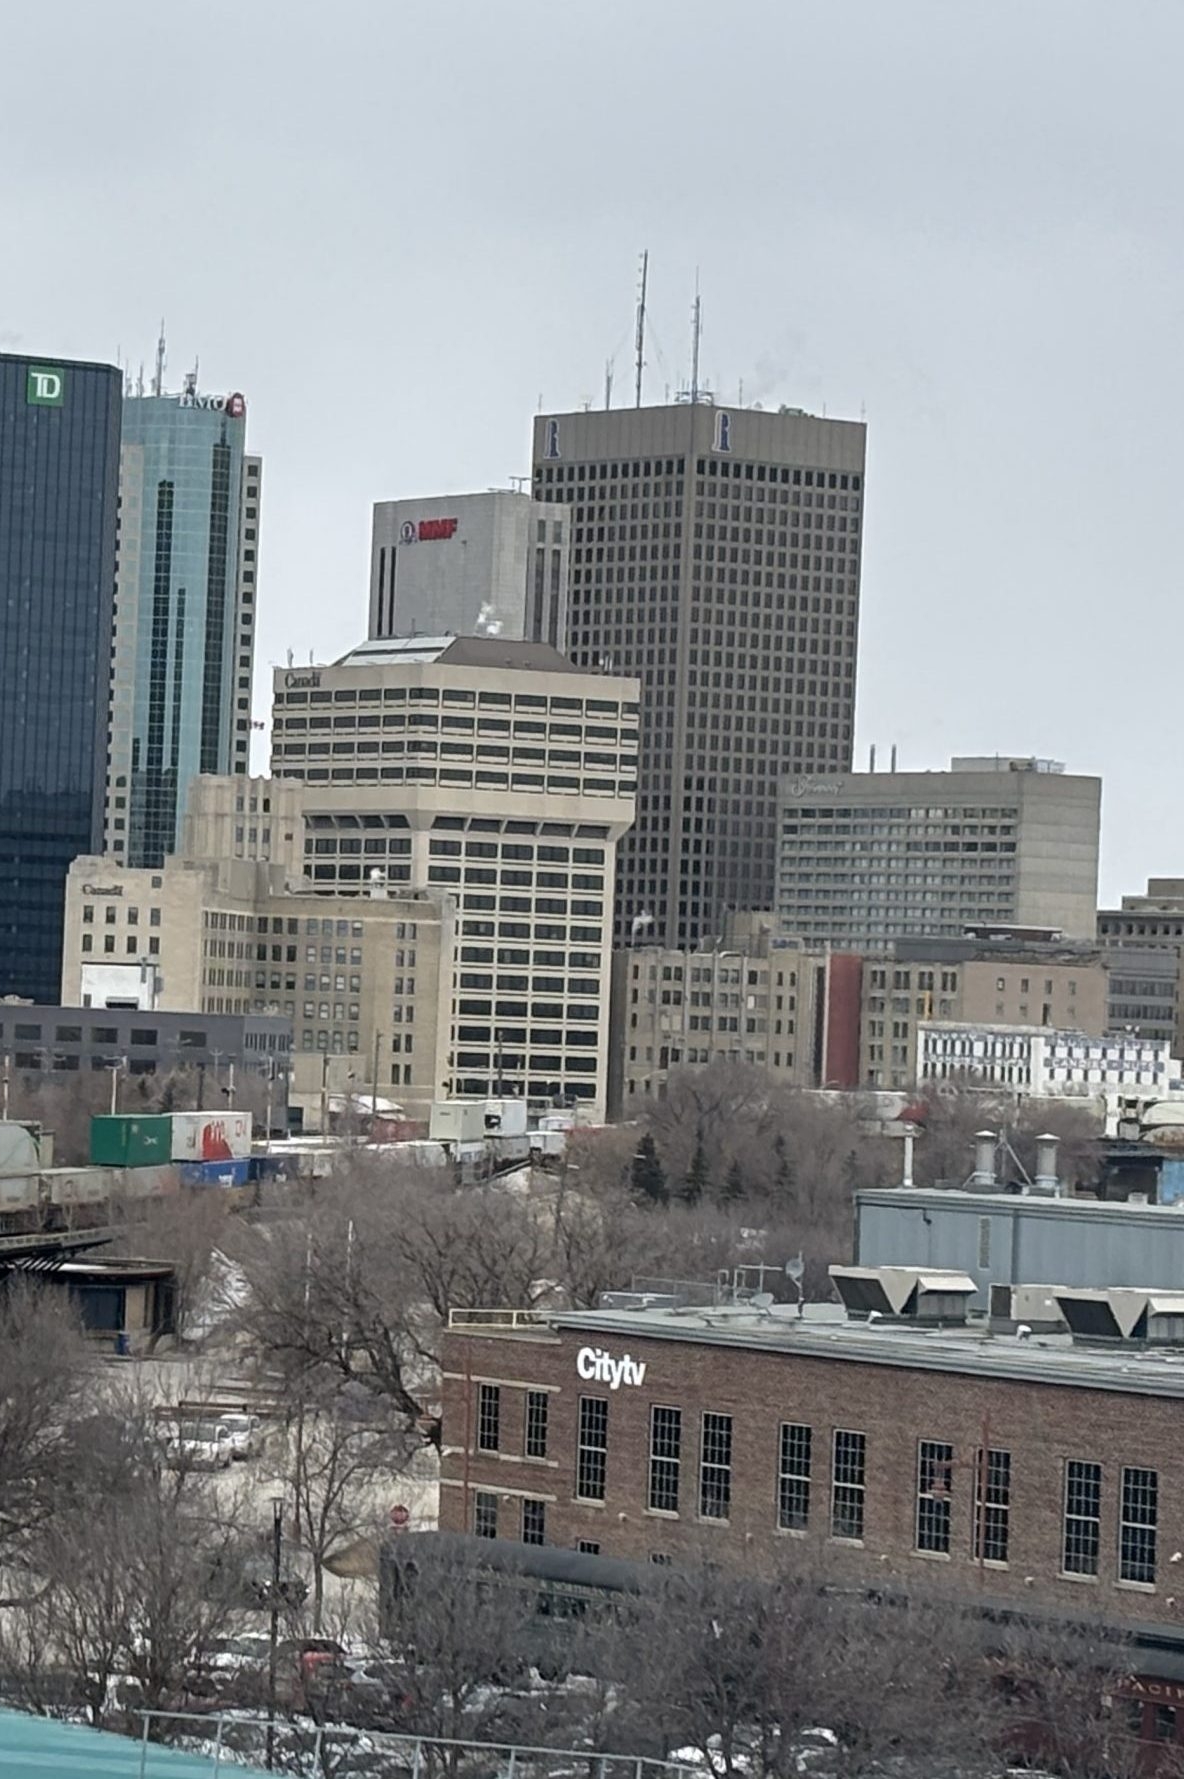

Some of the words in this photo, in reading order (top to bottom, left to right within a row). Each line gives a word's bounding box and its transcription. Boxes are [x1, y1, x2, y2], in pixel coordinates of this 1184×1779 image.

[30, 371, 62, 399] TD
[178, 393, 229, 412] BMO
[418, 517, 459, 541] MMF
[576, 1346, 647, 1391] Citytv
